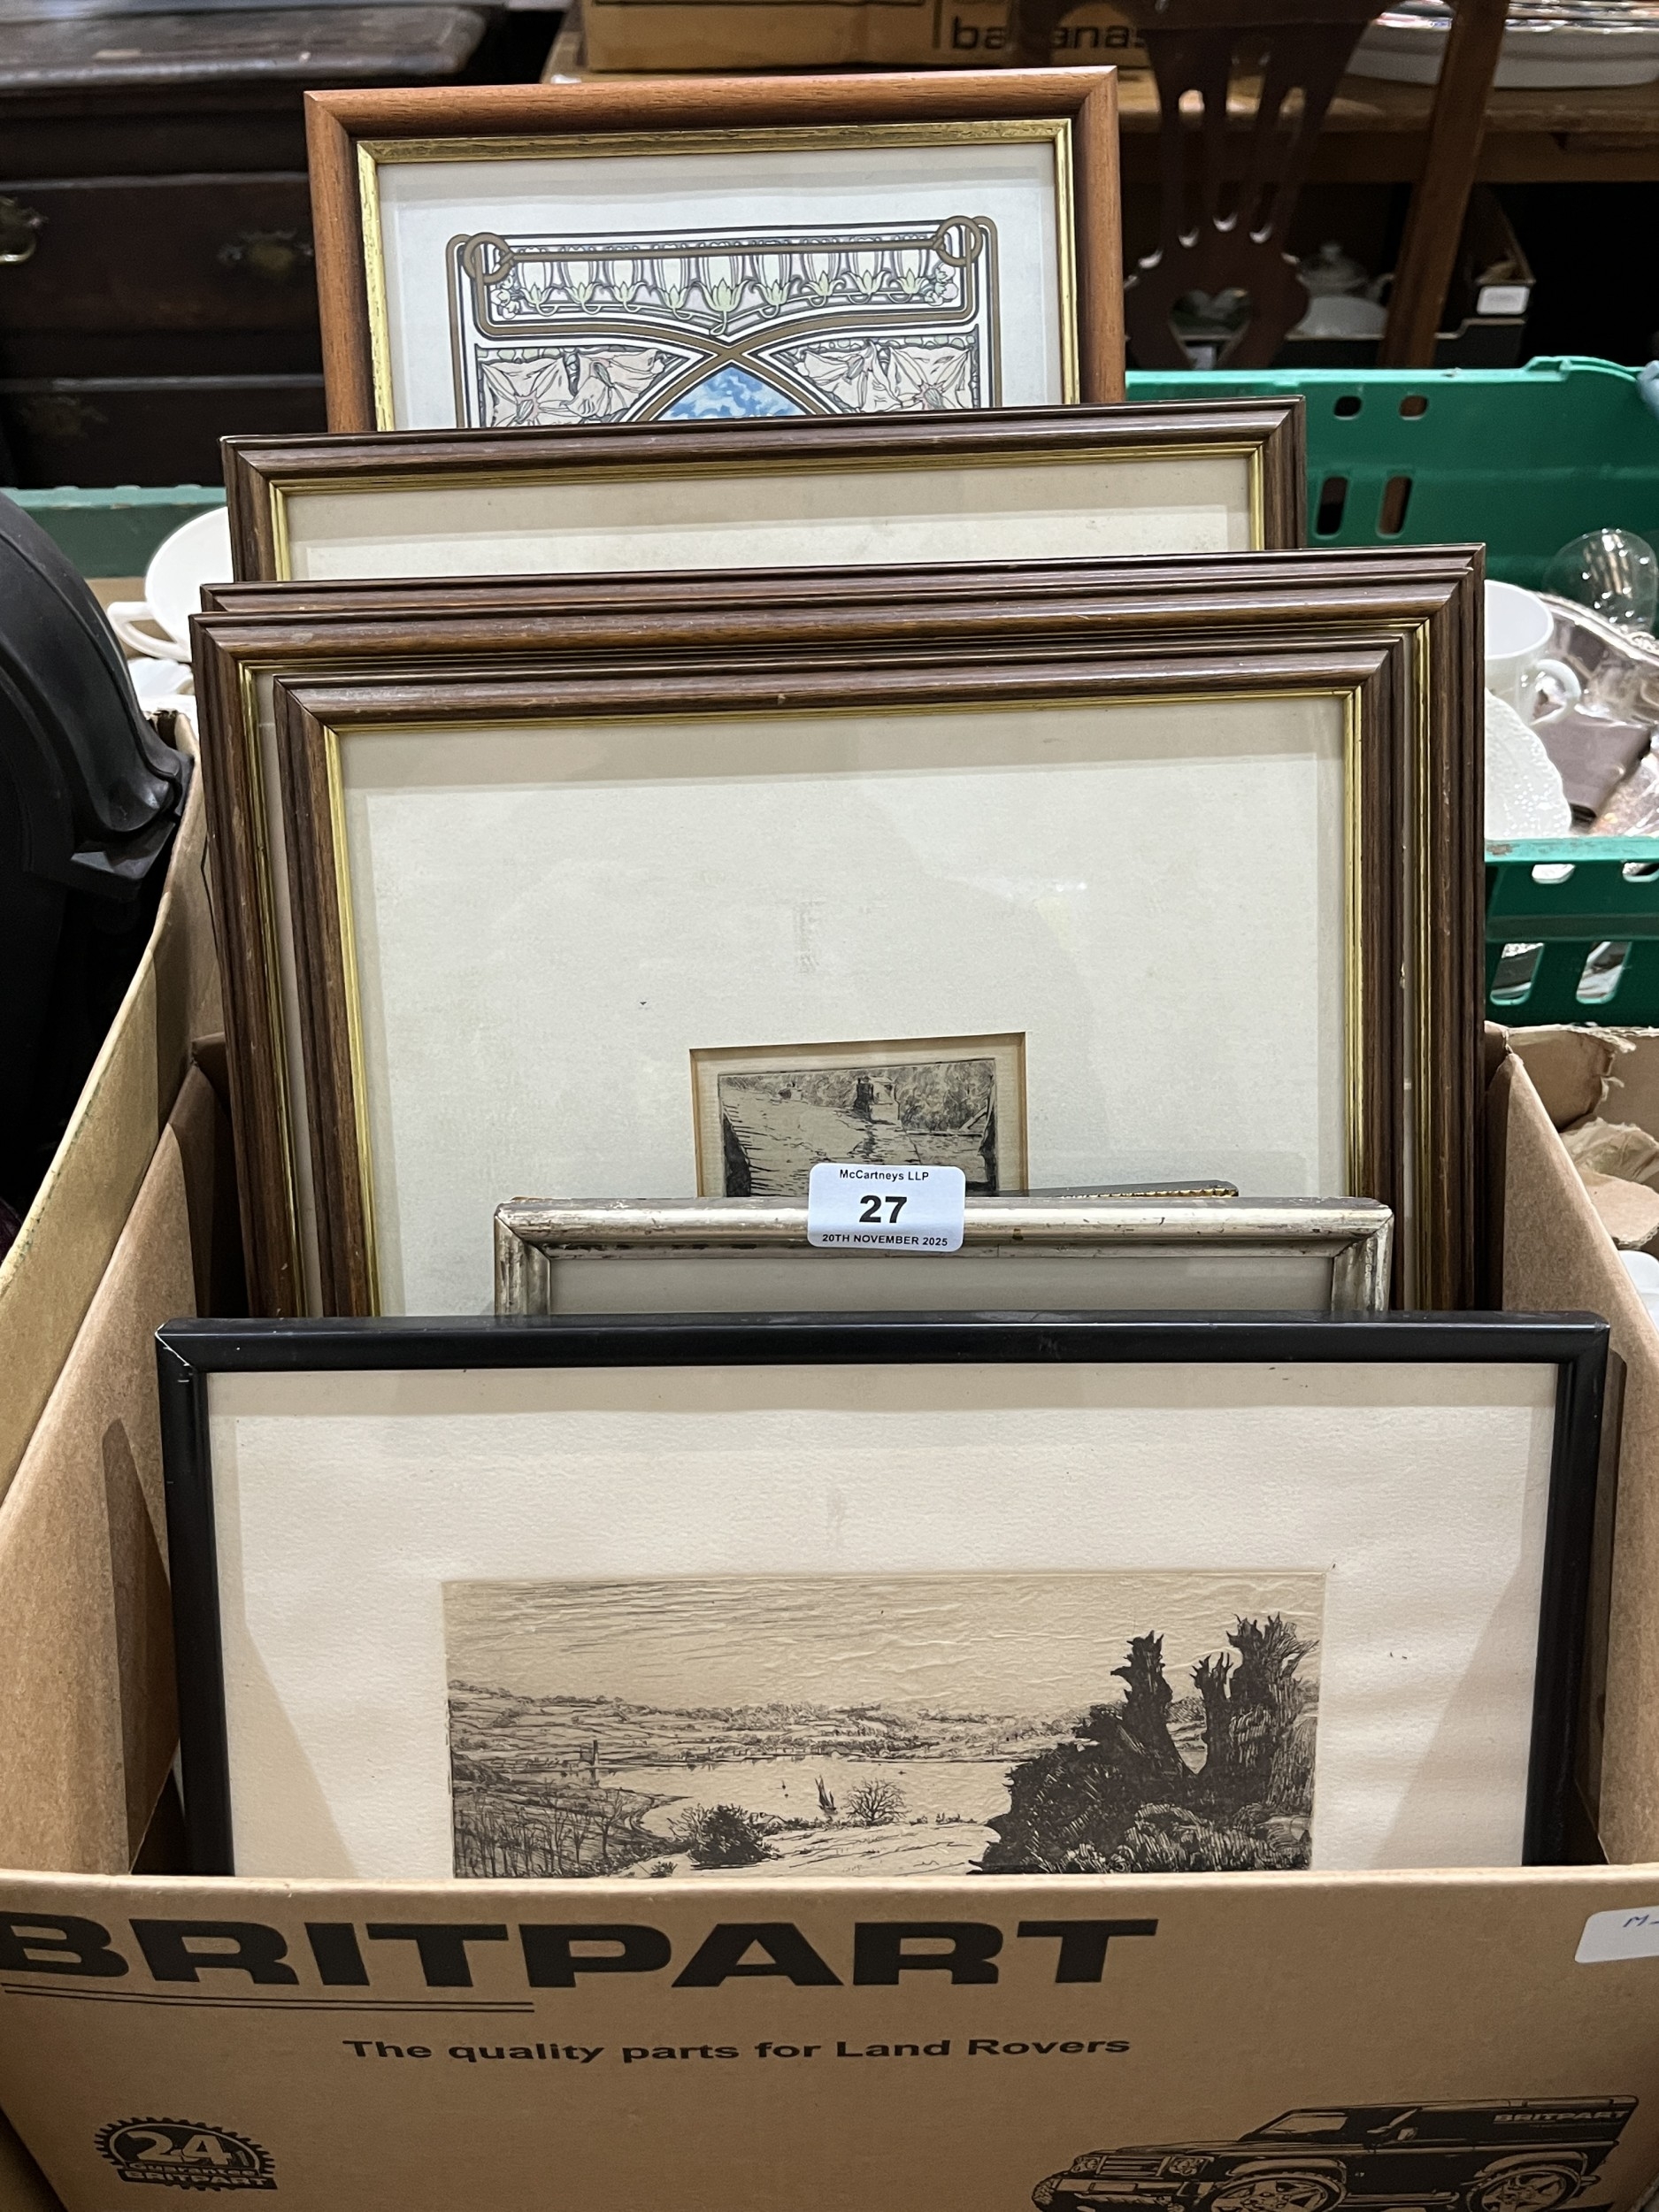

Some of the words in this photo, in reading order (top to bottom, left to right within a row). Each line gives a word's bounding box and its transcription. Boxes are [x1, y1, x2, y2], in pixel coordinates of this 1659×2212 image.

[952, 15, 1148, 50] baanas
[840, 1169, 904, 1182] McCartneys
[908, 1171, 929, 1181] LLP
[859, 1194, 908, 1224] 27
[822, 1233, 849, 1243] 20TH
[853, 1234, 918, 1245] NOVEMBER
[923, 1237, 948, 1247] 2025
[0, 1911, 1158, 1987] BRITPART
[342, 2039, 433, 2059] The
[449, 2040, 604, 2063] quality
[622, 2041, 740, 2064] parts
[755, 2041, 821, 2058] for
[836, 2039, 950, 2058] Land
[968, 2038, 1131, 2056] Rovers
[126, 2130, 233, 2167] 24
[123, 2170, 268, 2186] BRITPART
